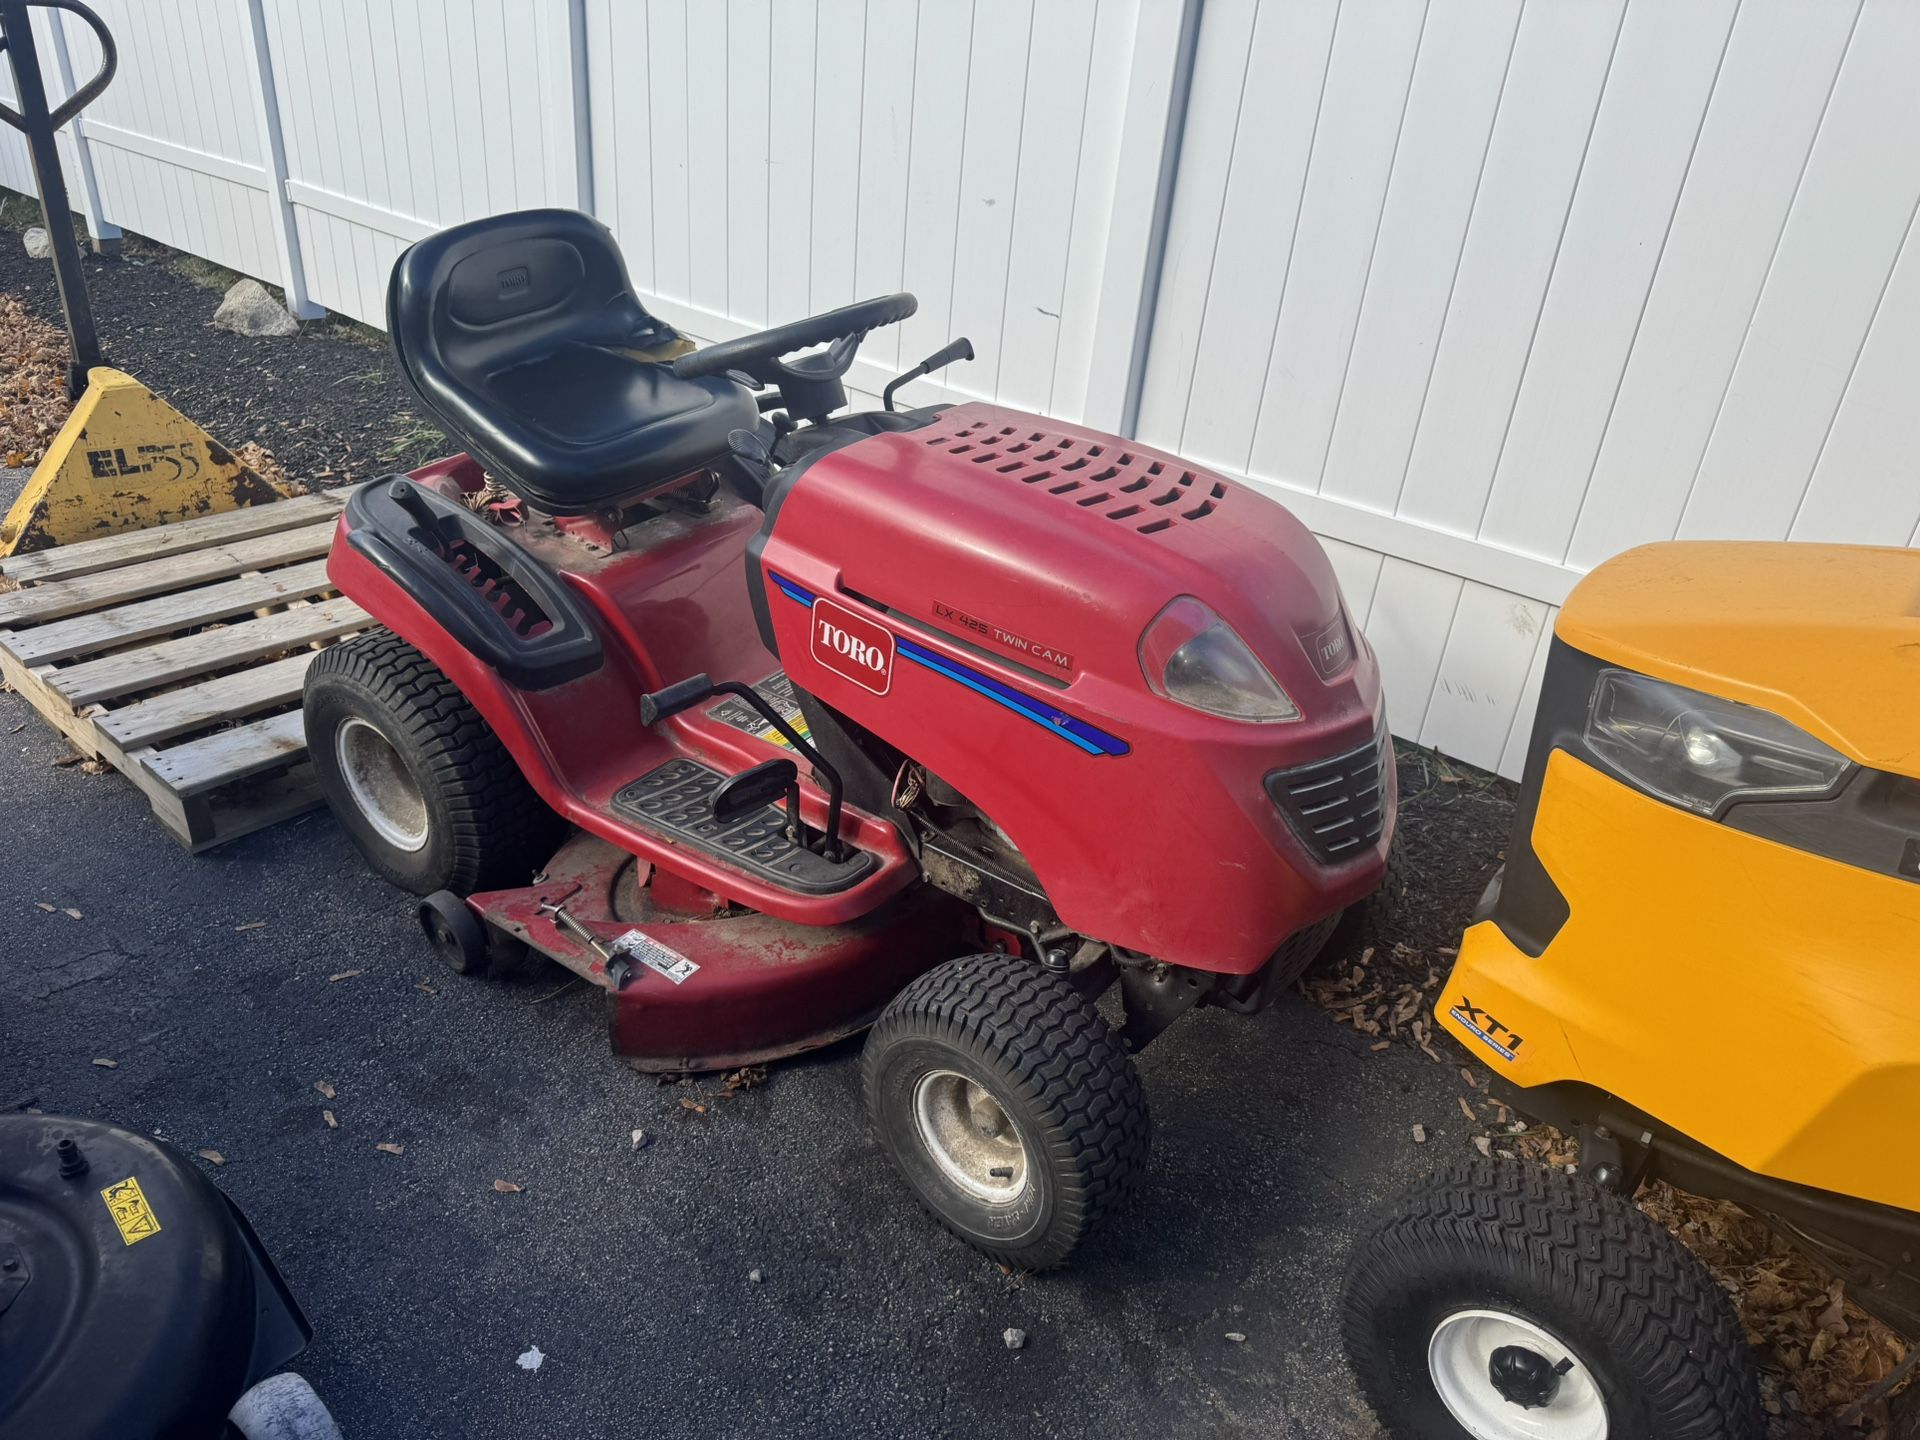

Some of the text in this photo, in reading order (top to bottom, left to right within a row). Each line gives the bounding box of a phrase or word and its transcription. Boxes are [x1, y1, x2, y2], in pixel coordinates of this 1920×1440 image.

[818, 620, 884, 672] TORO
[934, 603, 1069, 667] LX 425 TWIN CAM
[1320, 634, 1344, 660] TORO
[1450, 1008, 1511, 1058] ENDURO SERIES
[1453, 995, 1523, 1051] XT1
